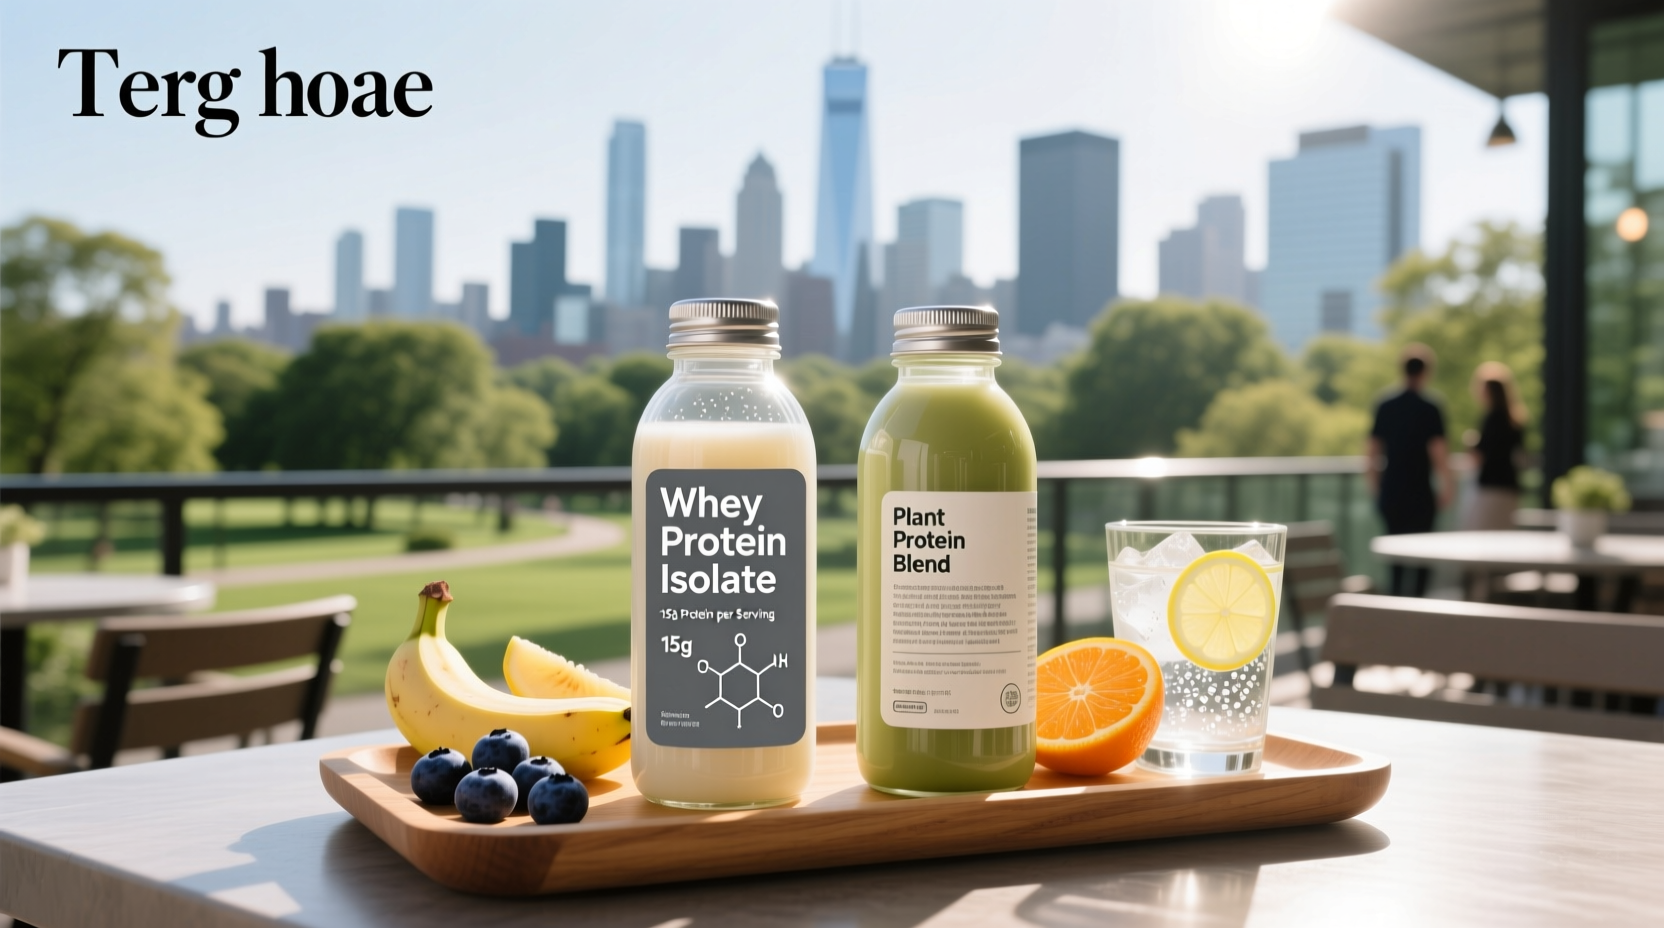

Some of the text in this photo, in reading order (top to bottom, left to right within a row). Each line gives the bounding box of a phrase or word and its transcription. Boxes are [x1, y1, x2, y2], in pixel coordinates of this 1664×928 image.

[660, 485, 763, 526] Whey
[893, 506, 946, 527] Plant
[661, 524, 787, 557] Protein
[893, 530, 966, 549] Protein
[893, 553, 951, 573] Blend
[661, 562, 777, 594] Isolate
[716, 610, 734, 623] per
[661, 634, 693, 658] 15g
